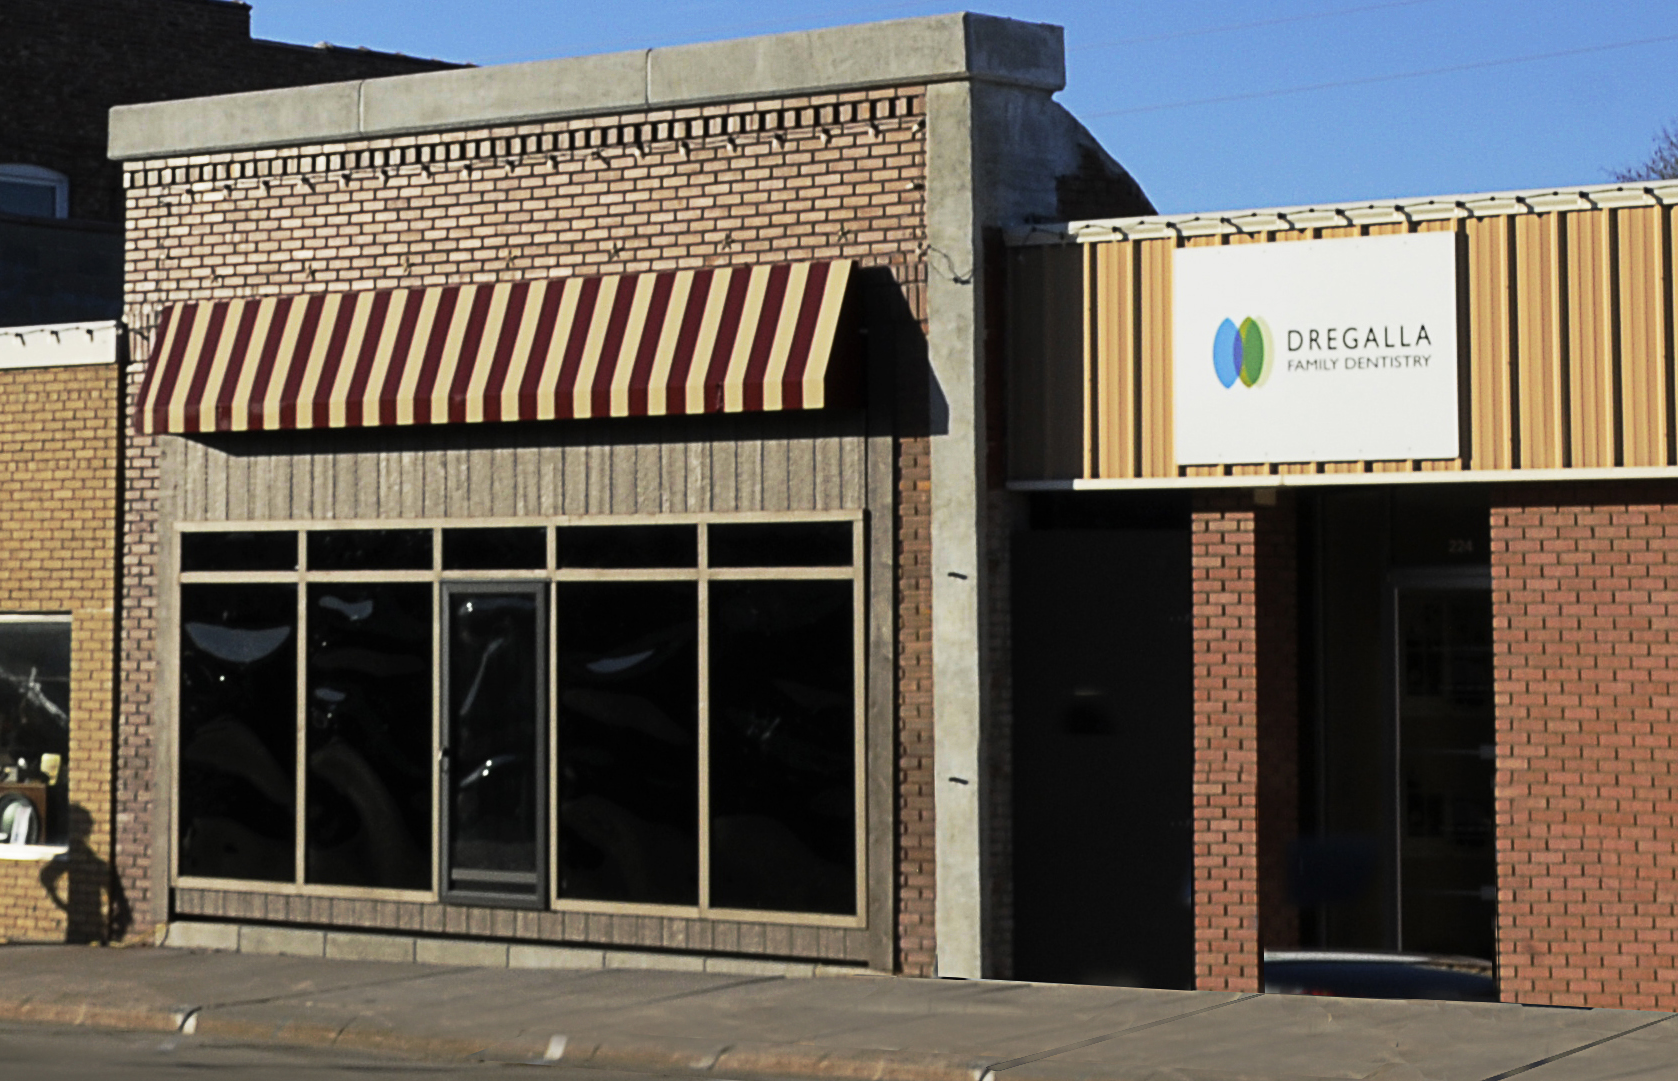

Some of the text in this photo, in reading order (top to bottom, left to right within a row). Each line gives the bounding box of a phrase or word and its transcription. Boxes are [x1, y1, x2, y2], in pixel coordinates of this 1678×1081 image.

[1287, 324, 1432, 352] DREGALLA
[1287, 354, 1432, 372] FAMILY DENTISTRY
[1448, 539, 1474, 553] 224
